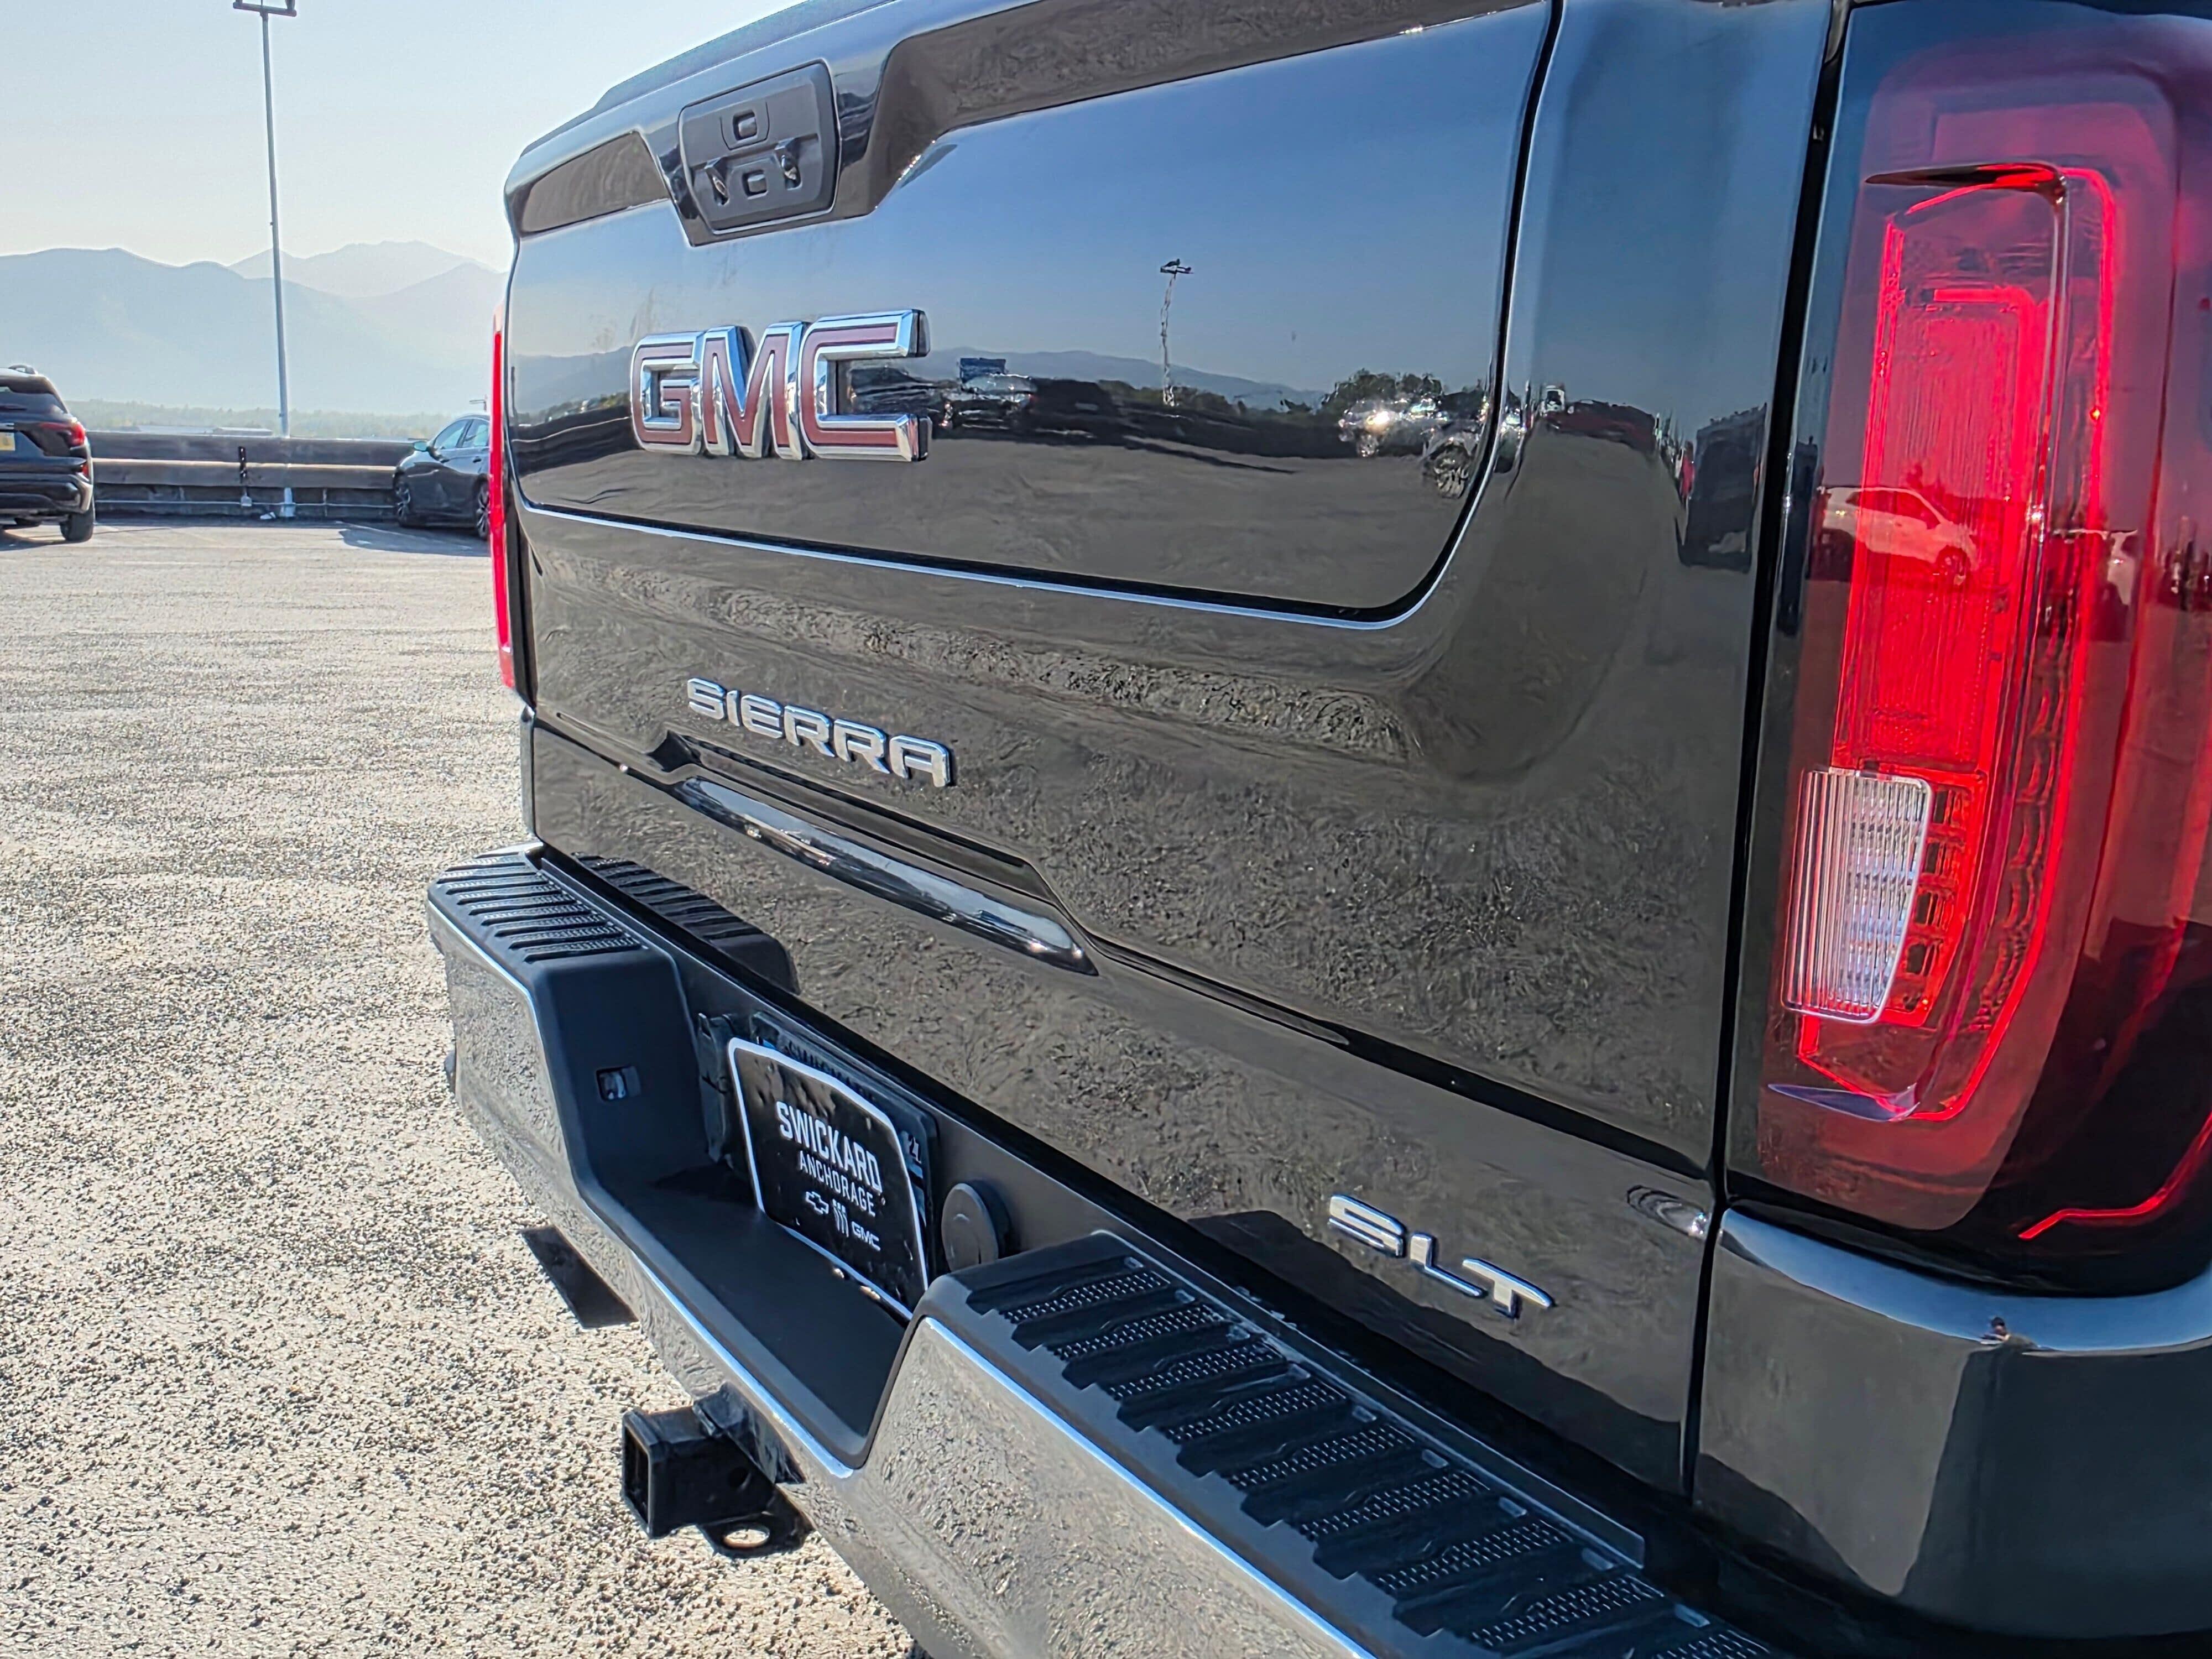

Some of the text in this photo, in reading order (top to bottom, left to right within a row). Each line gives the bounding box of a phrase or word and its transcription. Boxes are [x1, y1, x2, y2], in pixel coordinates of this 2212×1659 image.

[630, 309, 931, 461] GMC
[687, 677, 950, 787] SIERRA
[776, 1101, 883, 1193] SWICKARD
[799, 1150, 875, 1217] ANCHORAGE
[851, 1221, 880, 1251] GMC
[1329, 1193, 1553, 1317] SLT
